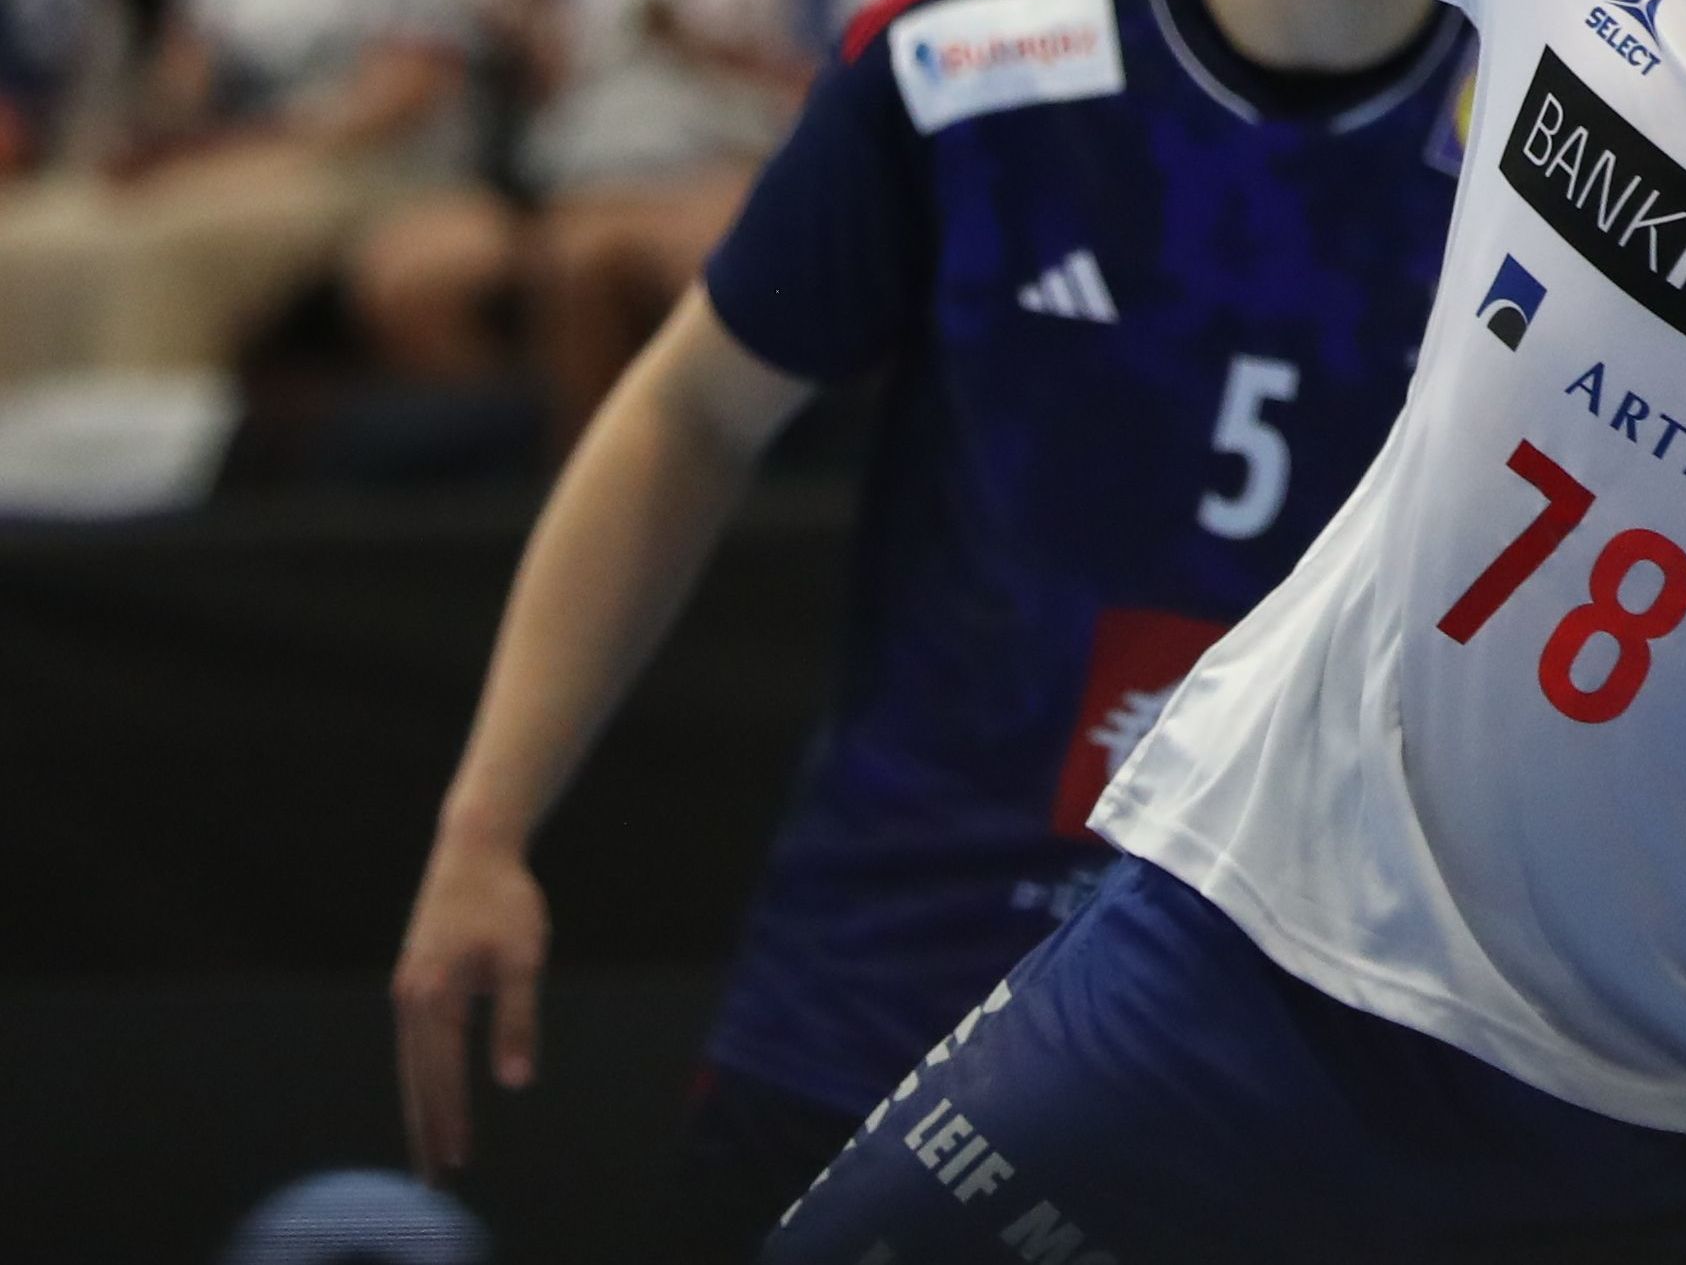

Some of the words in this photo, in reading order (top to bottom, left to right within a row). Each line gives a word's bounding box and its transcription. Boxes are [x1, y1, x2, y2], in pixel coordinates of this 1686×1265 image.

[1585, 6, 1661, 77] SELECT
[1196, 351, 1301, 540] 5
[903, 1097, 1016, 1204] LEIF
